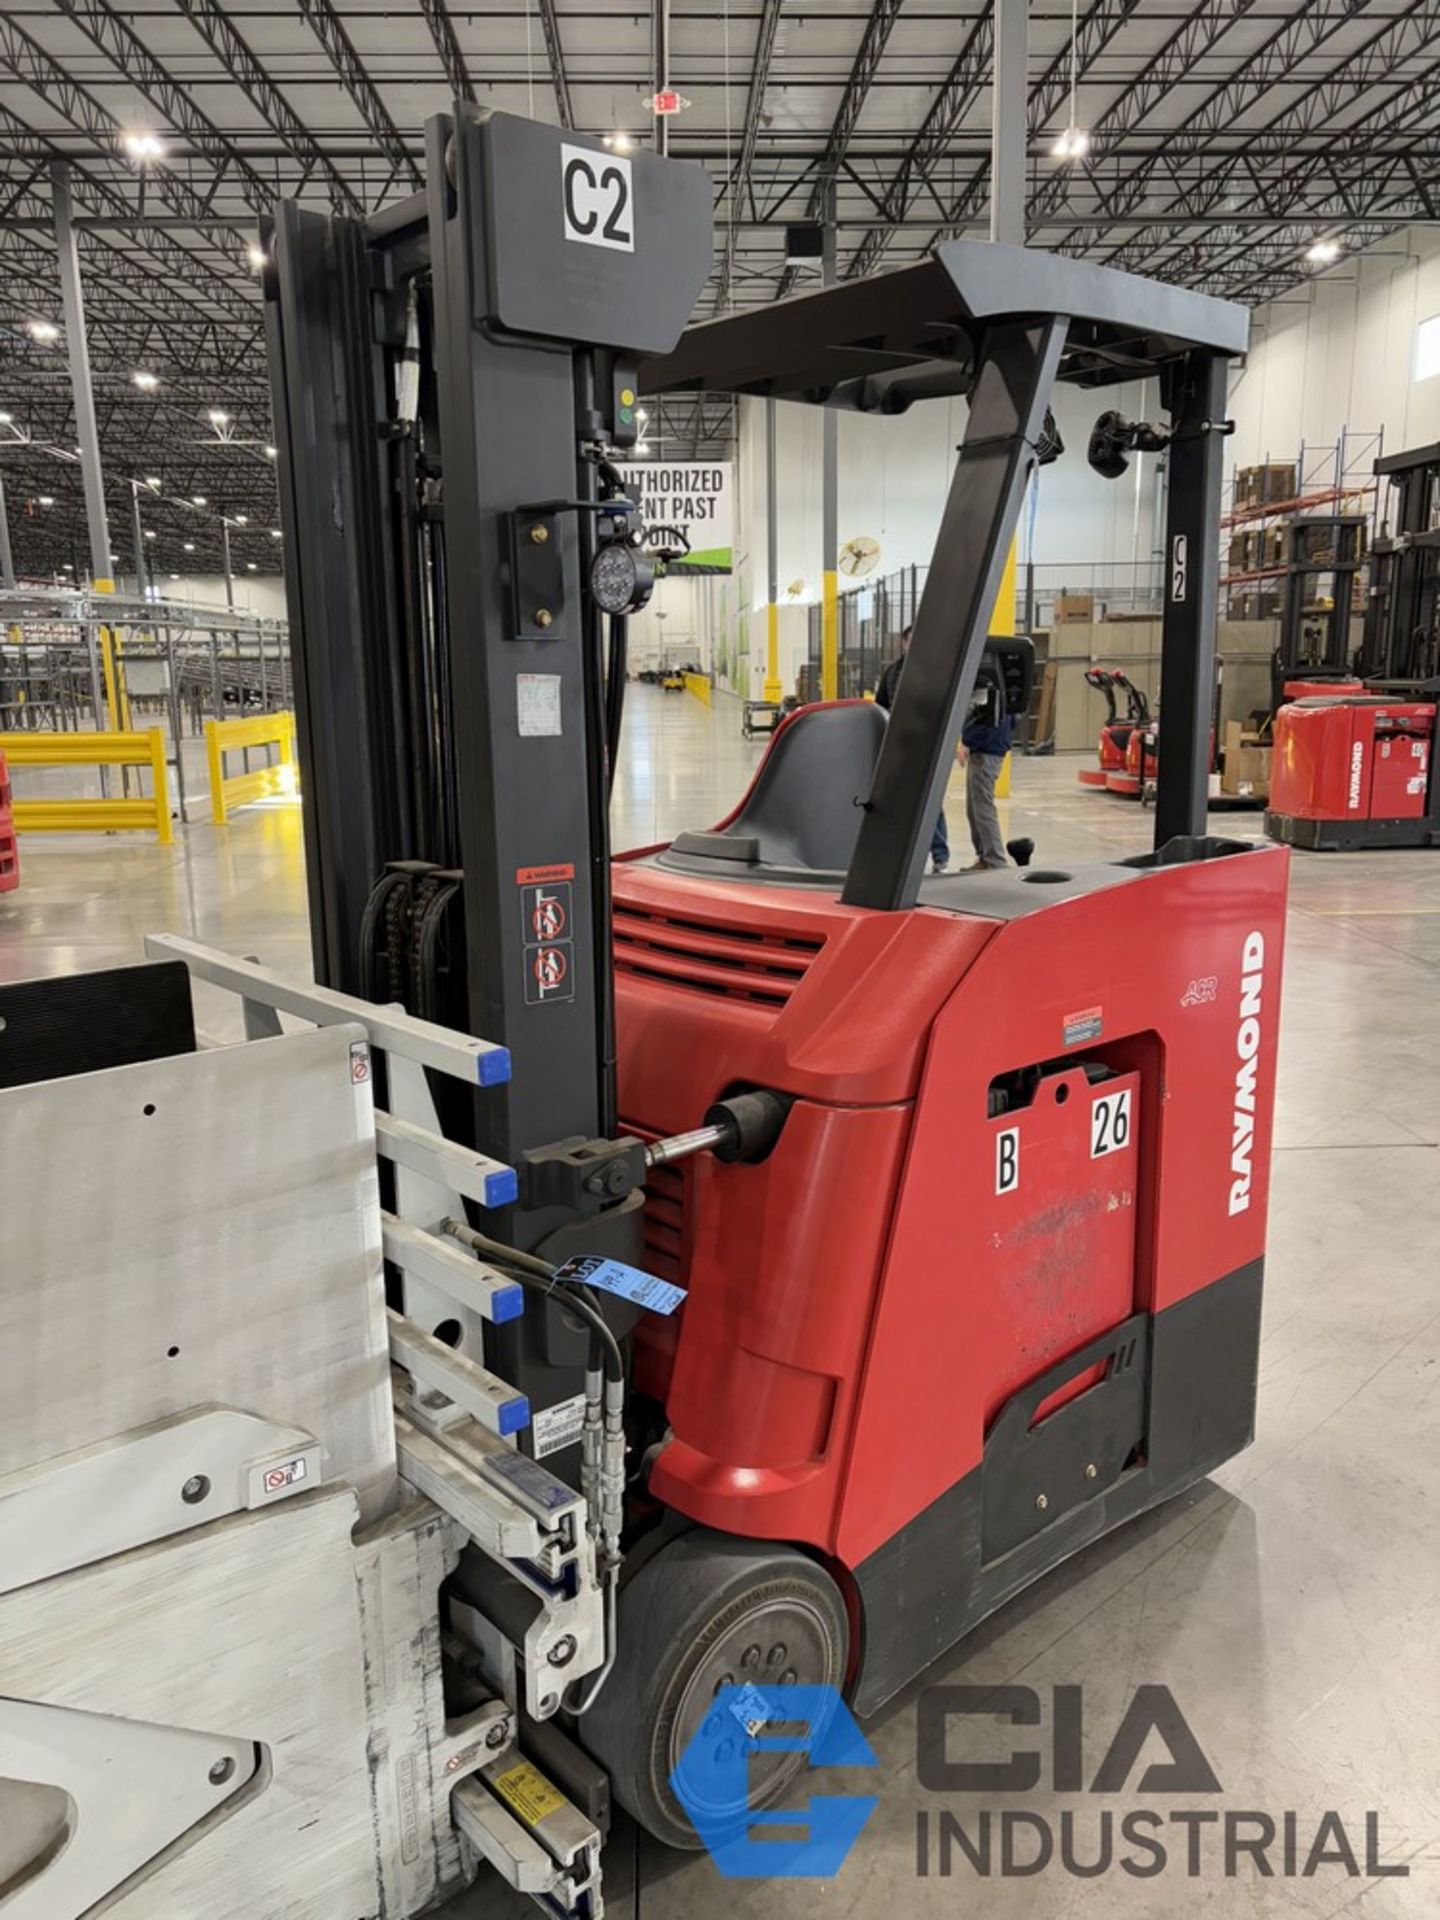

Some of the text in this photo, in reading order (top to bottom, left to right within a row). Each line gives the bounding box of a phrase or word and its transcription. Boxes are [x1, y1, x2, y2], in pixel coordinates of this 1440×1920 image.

[564, 158, 631, 244] C2
[622, 469, 723, 492] UTHORIZED
[672, 497, 717, 519] PAST
[1174, 536, 1185, 600] C2
[1348, 741, 1364, 809] RAYMOND
[1180, 975, 1218, 1007] ACR
[1228, 930, 1265, 1217] RAYMOND
[1093, 1092, 1128, 1156] 26
[999, 1133, 1016, 1190] B
[570, 1258, 601, 1280] LOT
